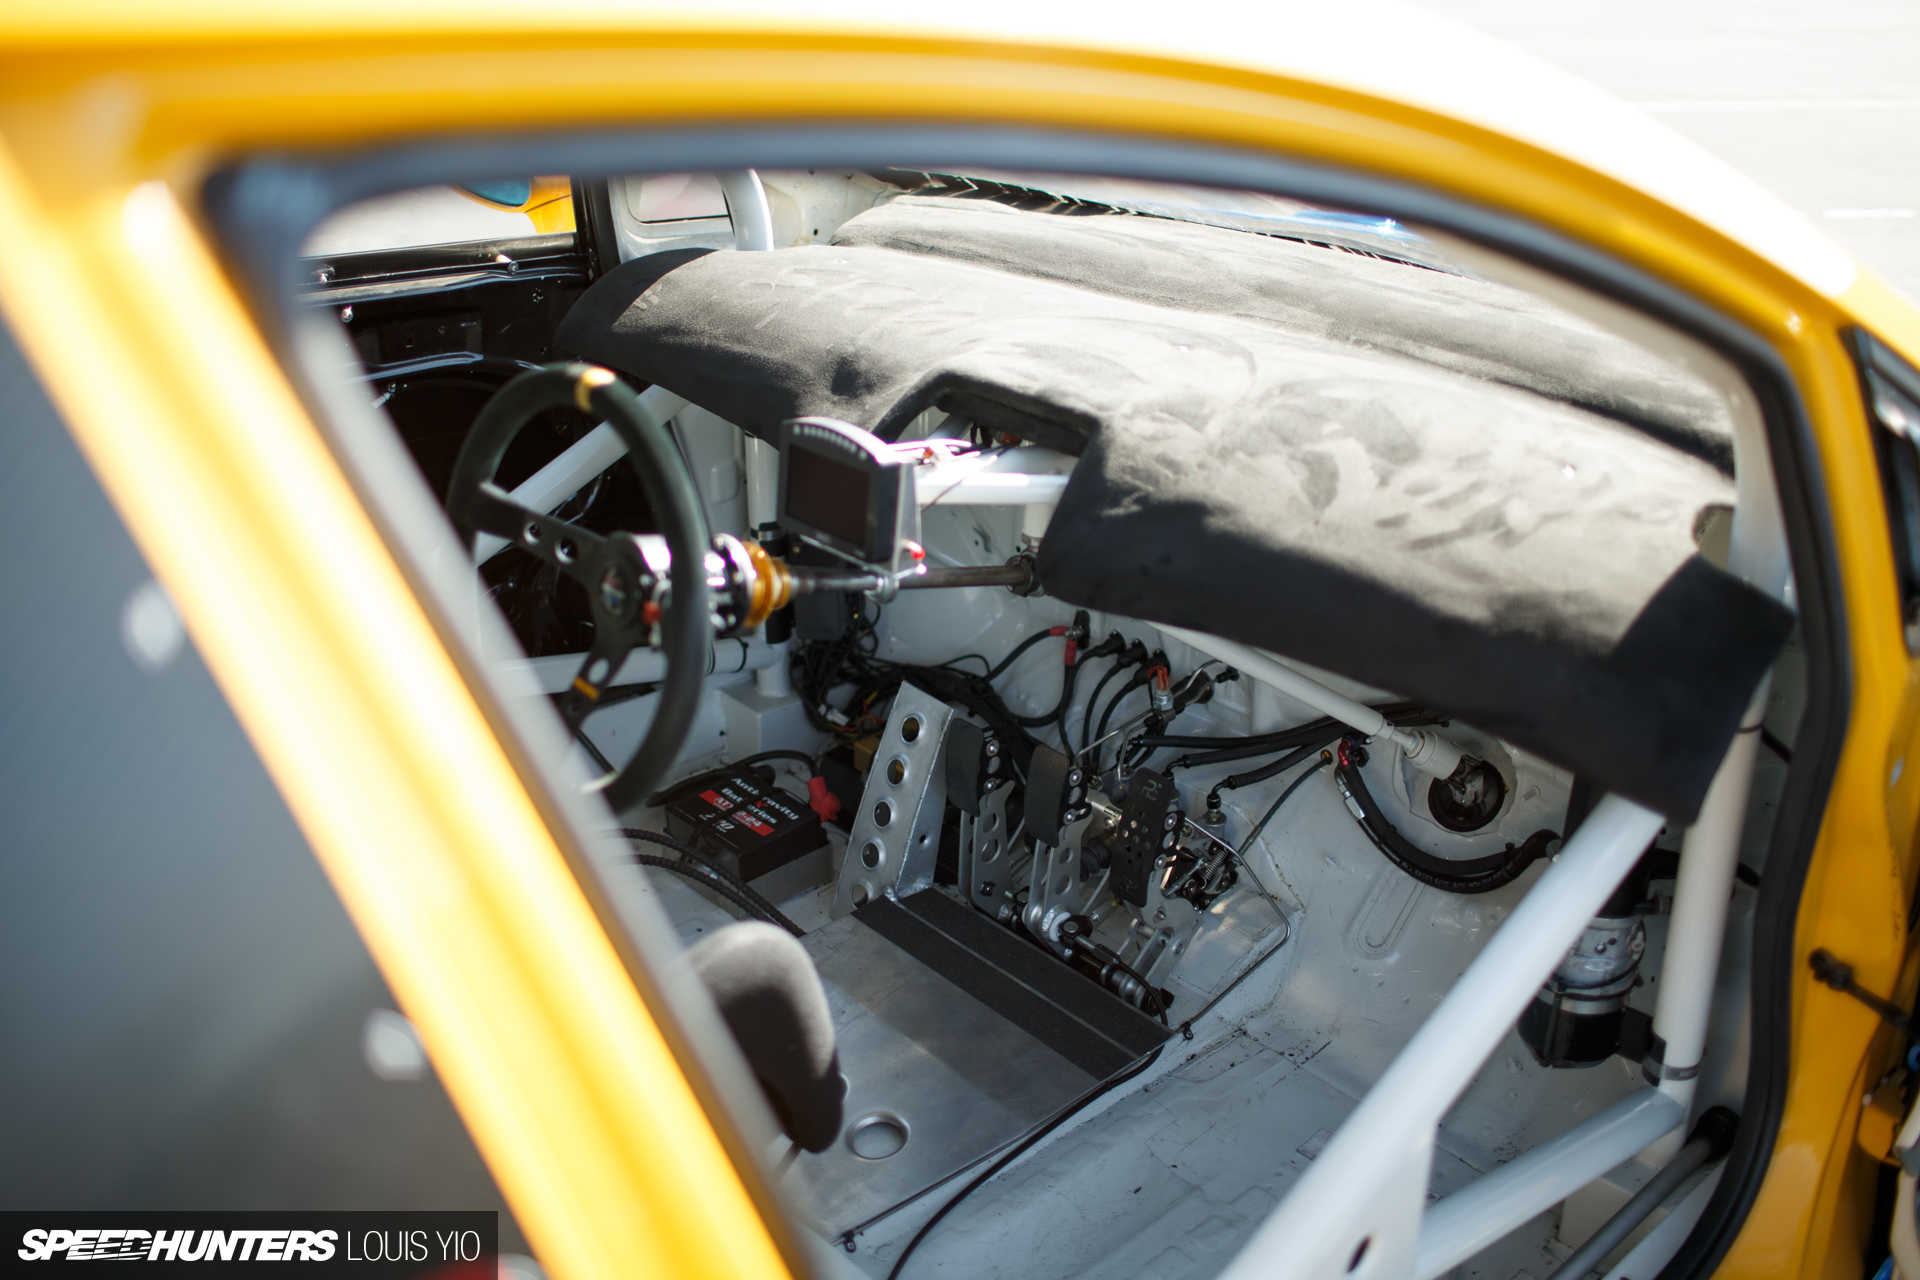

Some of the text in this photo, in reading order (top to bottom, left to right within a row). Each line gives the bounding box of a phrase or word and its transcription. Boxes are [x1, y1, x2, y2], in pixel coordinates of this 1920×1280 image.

[714, 797, 762, 827] AT2-24
[721, 787, 778, 824] Bateries
[731, 777, 800, 820] Antiravity
